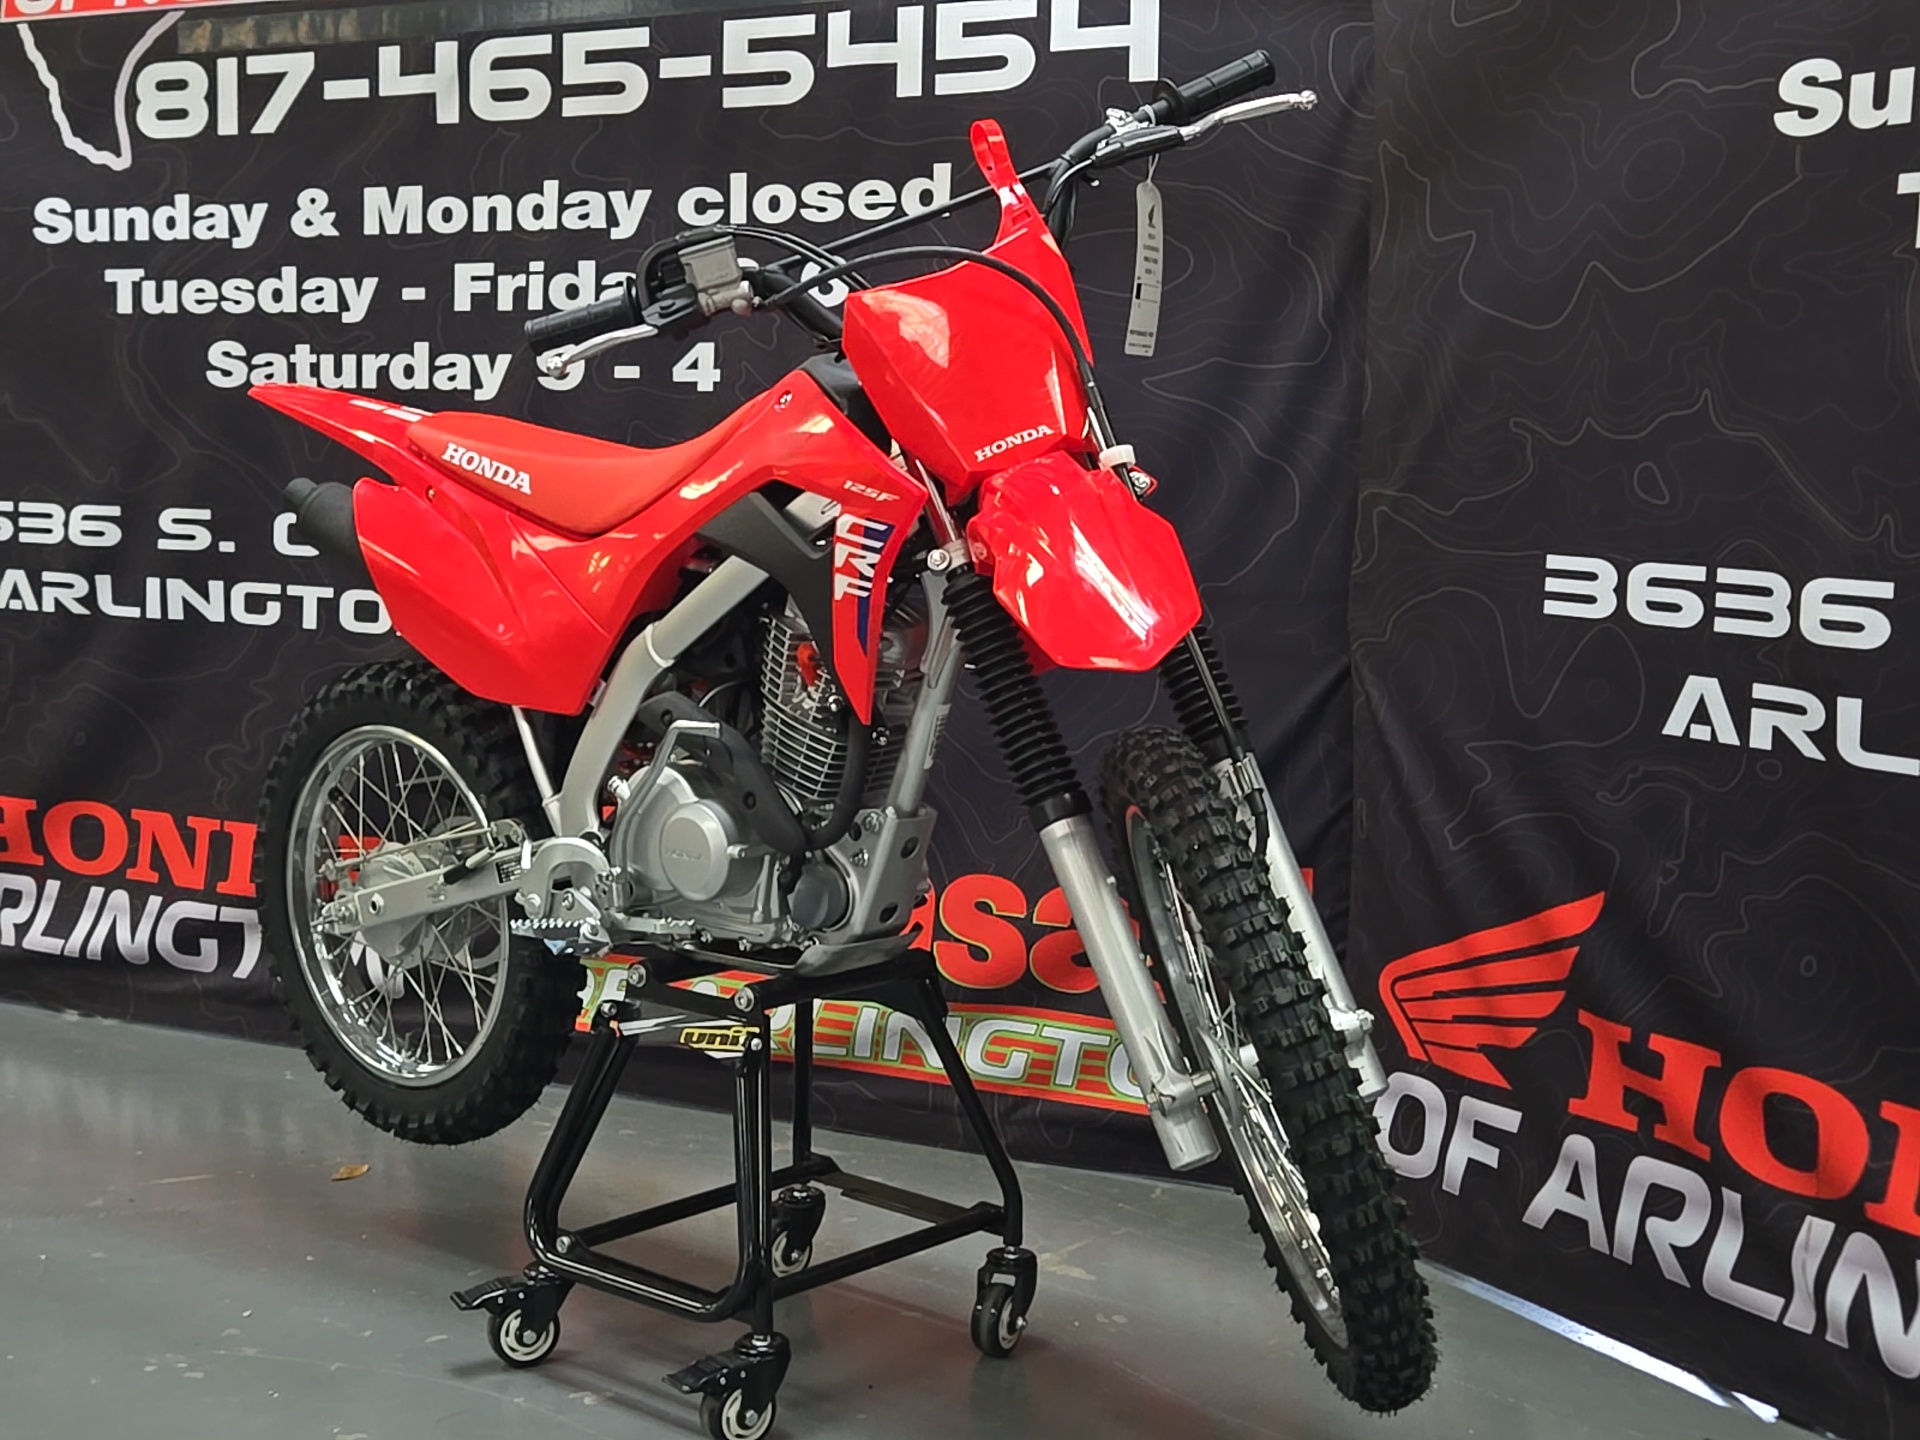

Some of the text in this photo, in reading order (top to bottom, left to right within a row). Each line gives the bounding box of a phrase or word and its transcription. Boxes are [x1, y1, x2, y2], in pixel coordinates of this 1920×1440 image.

[135, 0, 1160, 139] 817-465-5454
[33, 162, 953, 249] Sunday & Monday closed
[105, 266, 379, 324] Tuesday
[401, 286, 426, 301] -
[453, 260, 637, 312] Frida
[205, 340, 512, 402] Saturday
[614, 365, 640, 379] -
[672, 342, 721, 392] 4
[441, 443, 532, 495] HONDA
[974, 424, 1055, 463] HONDA
[843, 480, 901, 502] 125F
[157, 508, 235, 552] S.
[0, 568, 394, 636] ARLINGTO
[1543, 554, 1895, 650] 3636
[1372, 1071, 1522, 1196] OF
